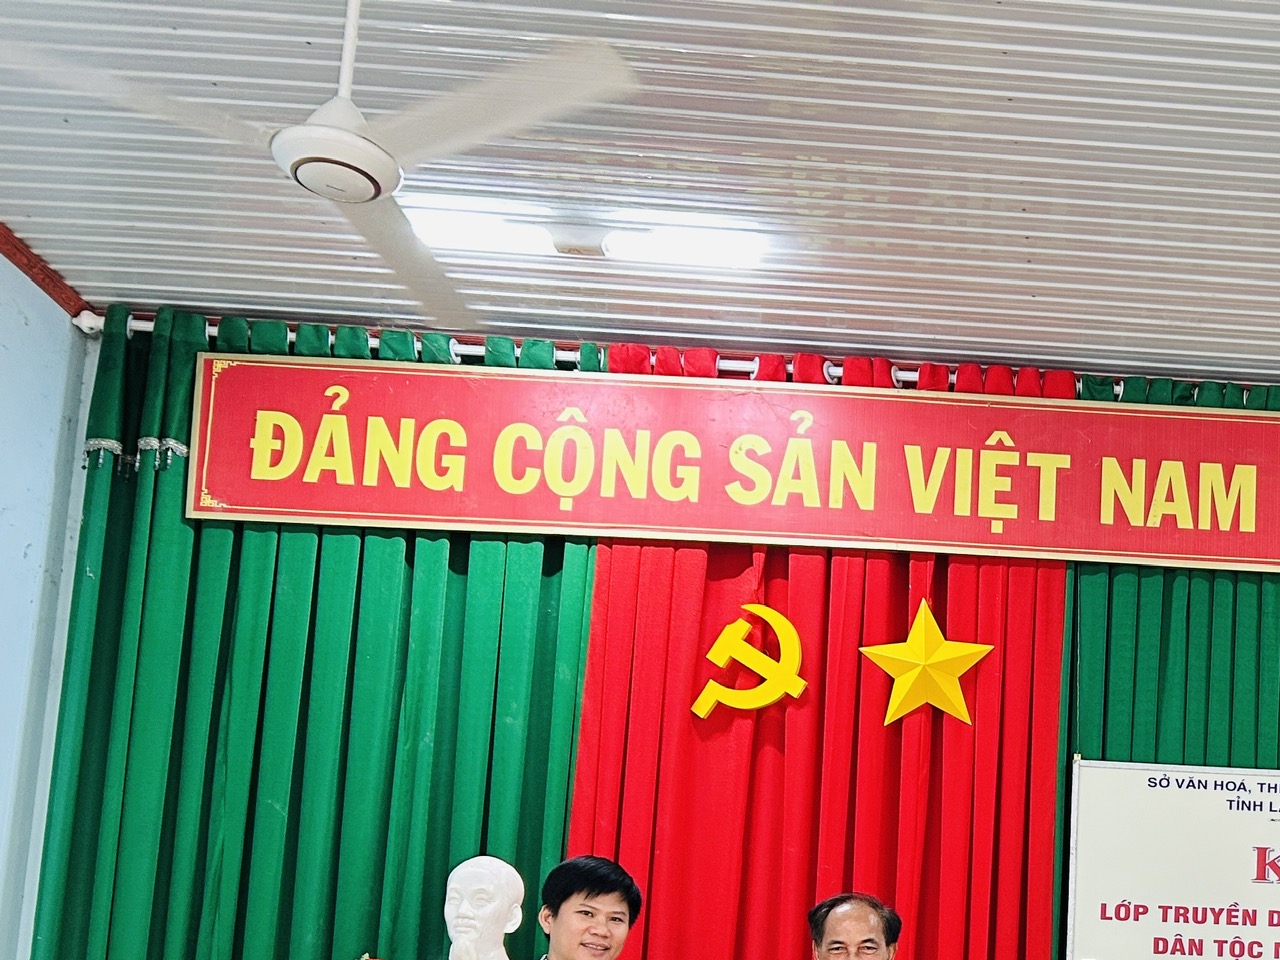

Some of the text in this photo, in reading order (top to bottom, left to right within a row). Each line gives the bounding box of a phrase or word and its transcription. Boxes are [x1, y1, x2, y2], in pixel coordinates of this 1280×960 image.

[251, 386, 467, 491] ĐẢNG
[494, 406, 700, 510] CỘNG
[724, 410, 877, 511] SẢN
[905, 431, 1070, 533] VIỆT
[1101, 457, 1256, 532] NAM
[1148, 774, 1170, 788] SỞ
[1175, 776, 1208, 789] VĂN
[1213, 779, 1252, 794] HOÁ,
[1226, 796, 1263, 811] TỈNH
[1100, 899, 1149, 922] LỚP
[1157, 902, 1258, 927] TRUYỀN
[1153, 934, 1204, 956] DÂN
[1213, 936, 1263, 960] TỘC
